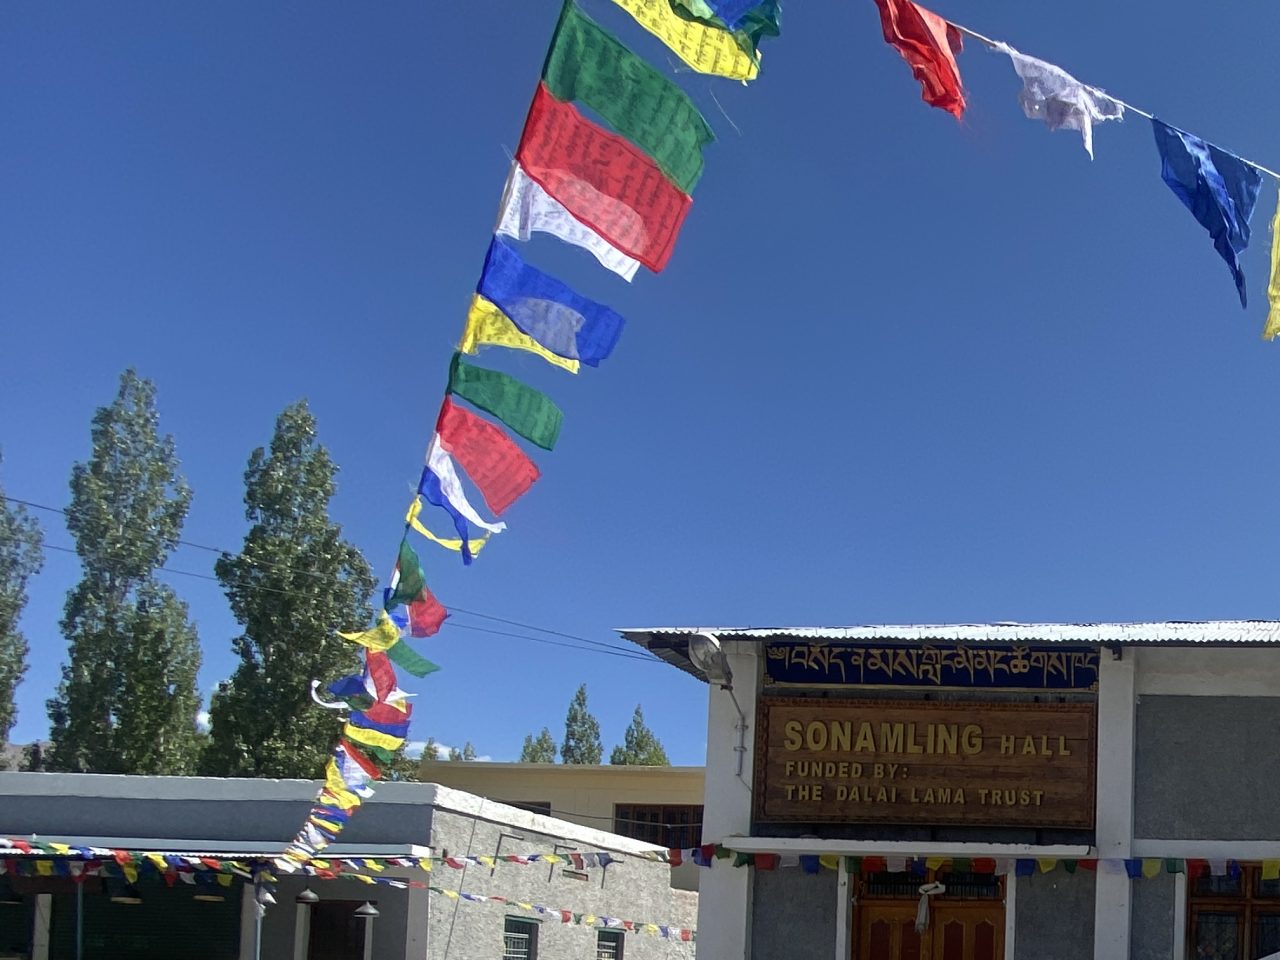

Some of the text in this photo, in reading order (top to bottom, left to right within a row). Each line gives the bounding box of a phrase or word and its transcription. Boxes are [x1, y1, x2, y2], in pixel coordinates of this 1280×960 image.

[784, 720, 1072, 757] SONAMLING HALL
[785, 760, 910, 779] FUNDED BY:
[785, 784, 1044, 806] THE DALAI LAMA TRUST
